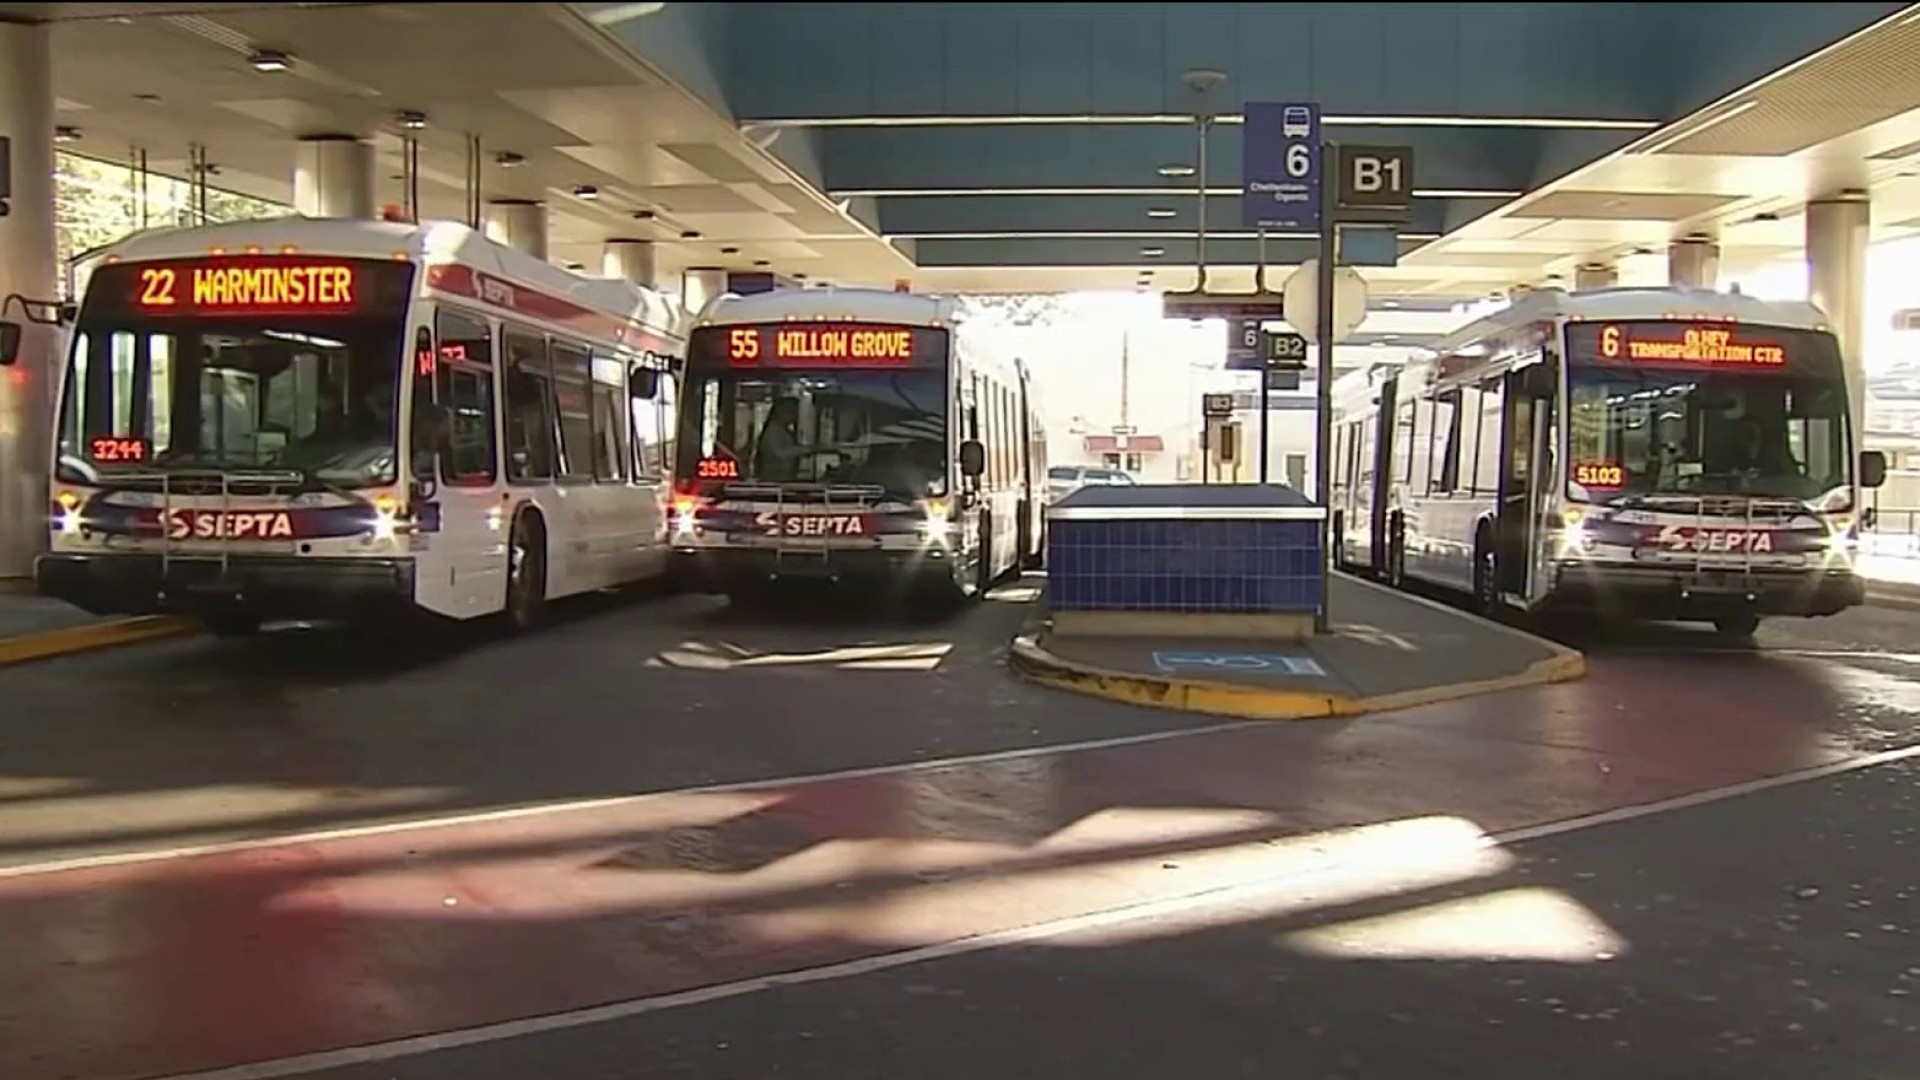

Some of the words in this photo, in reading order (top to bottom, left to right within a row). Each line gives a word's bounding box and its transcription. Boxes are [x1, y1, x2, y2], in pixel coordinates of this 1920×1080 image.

[1286, 144, 1310, 177] 6
[1353, 157, 1401, 192] B1
[141, 268, 176, 304] 22
[193, 266, 352, 304] WARMINSTER
[731, 329, 759, 358] 55
[777, 331, 847, 357] WILLOW
[851, 331, 911, 357] GROVE
[1245, 329, 1257, 346] 6
[1275, 337, 1304, 356] B2
[1602, 326, 1619, 357] 6
[1629, 341, 1751, 363] TRANSPORTATION
[1754, 347, 1784, 363] CTR
[93, 440, 143, 460] 3244
[698, 460, 738, 477] 3501
[1577, 466, 1622, 484] 5103
[194, 512, 293, 537] SEPTA
[785, 516, 863, 535] SEPTA
[1693, 531, 1772, 551] SEPTA
